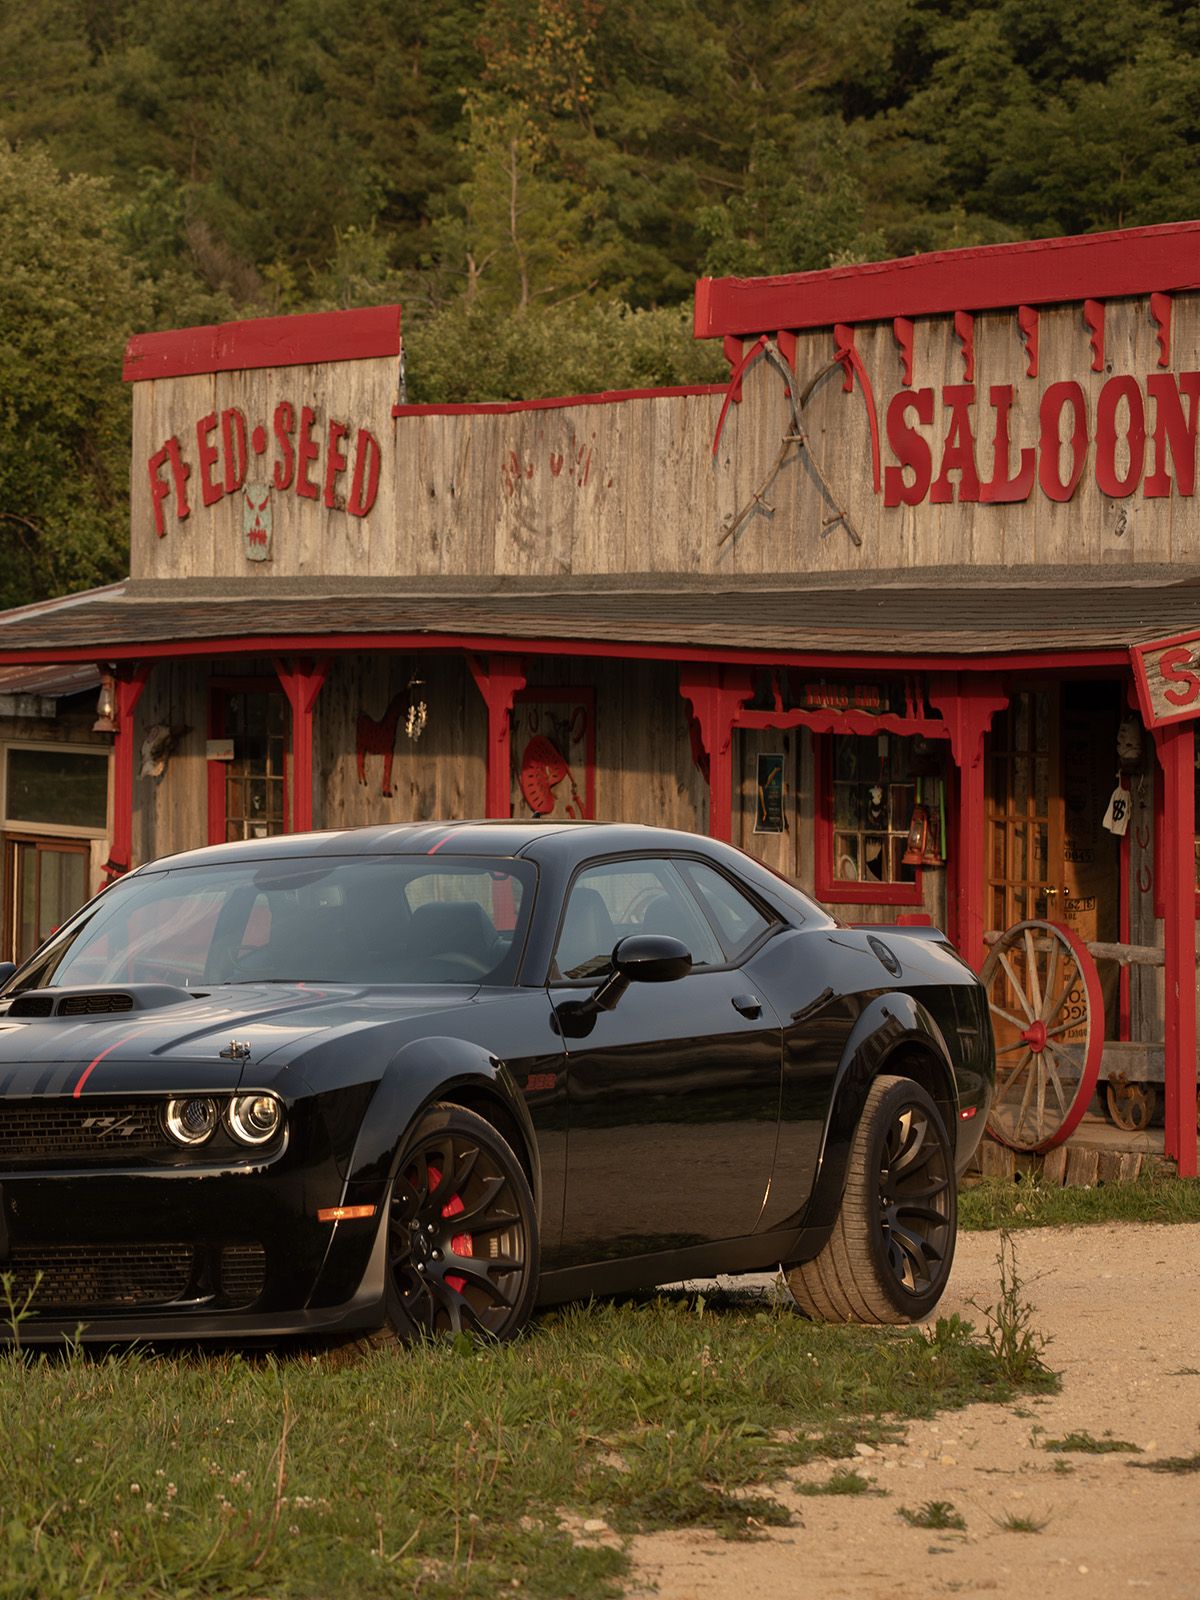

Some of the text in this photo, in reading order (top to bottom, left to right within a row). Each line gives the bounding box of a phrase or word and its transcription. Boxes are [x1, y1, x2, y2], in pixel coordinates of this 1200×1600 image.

[148, 407, 246, 538] FEED
[273, 401, 381, 517] SEED
[884, 371, 1200, 507] SALOON
[81, 1115, 144, 1137] R/T
